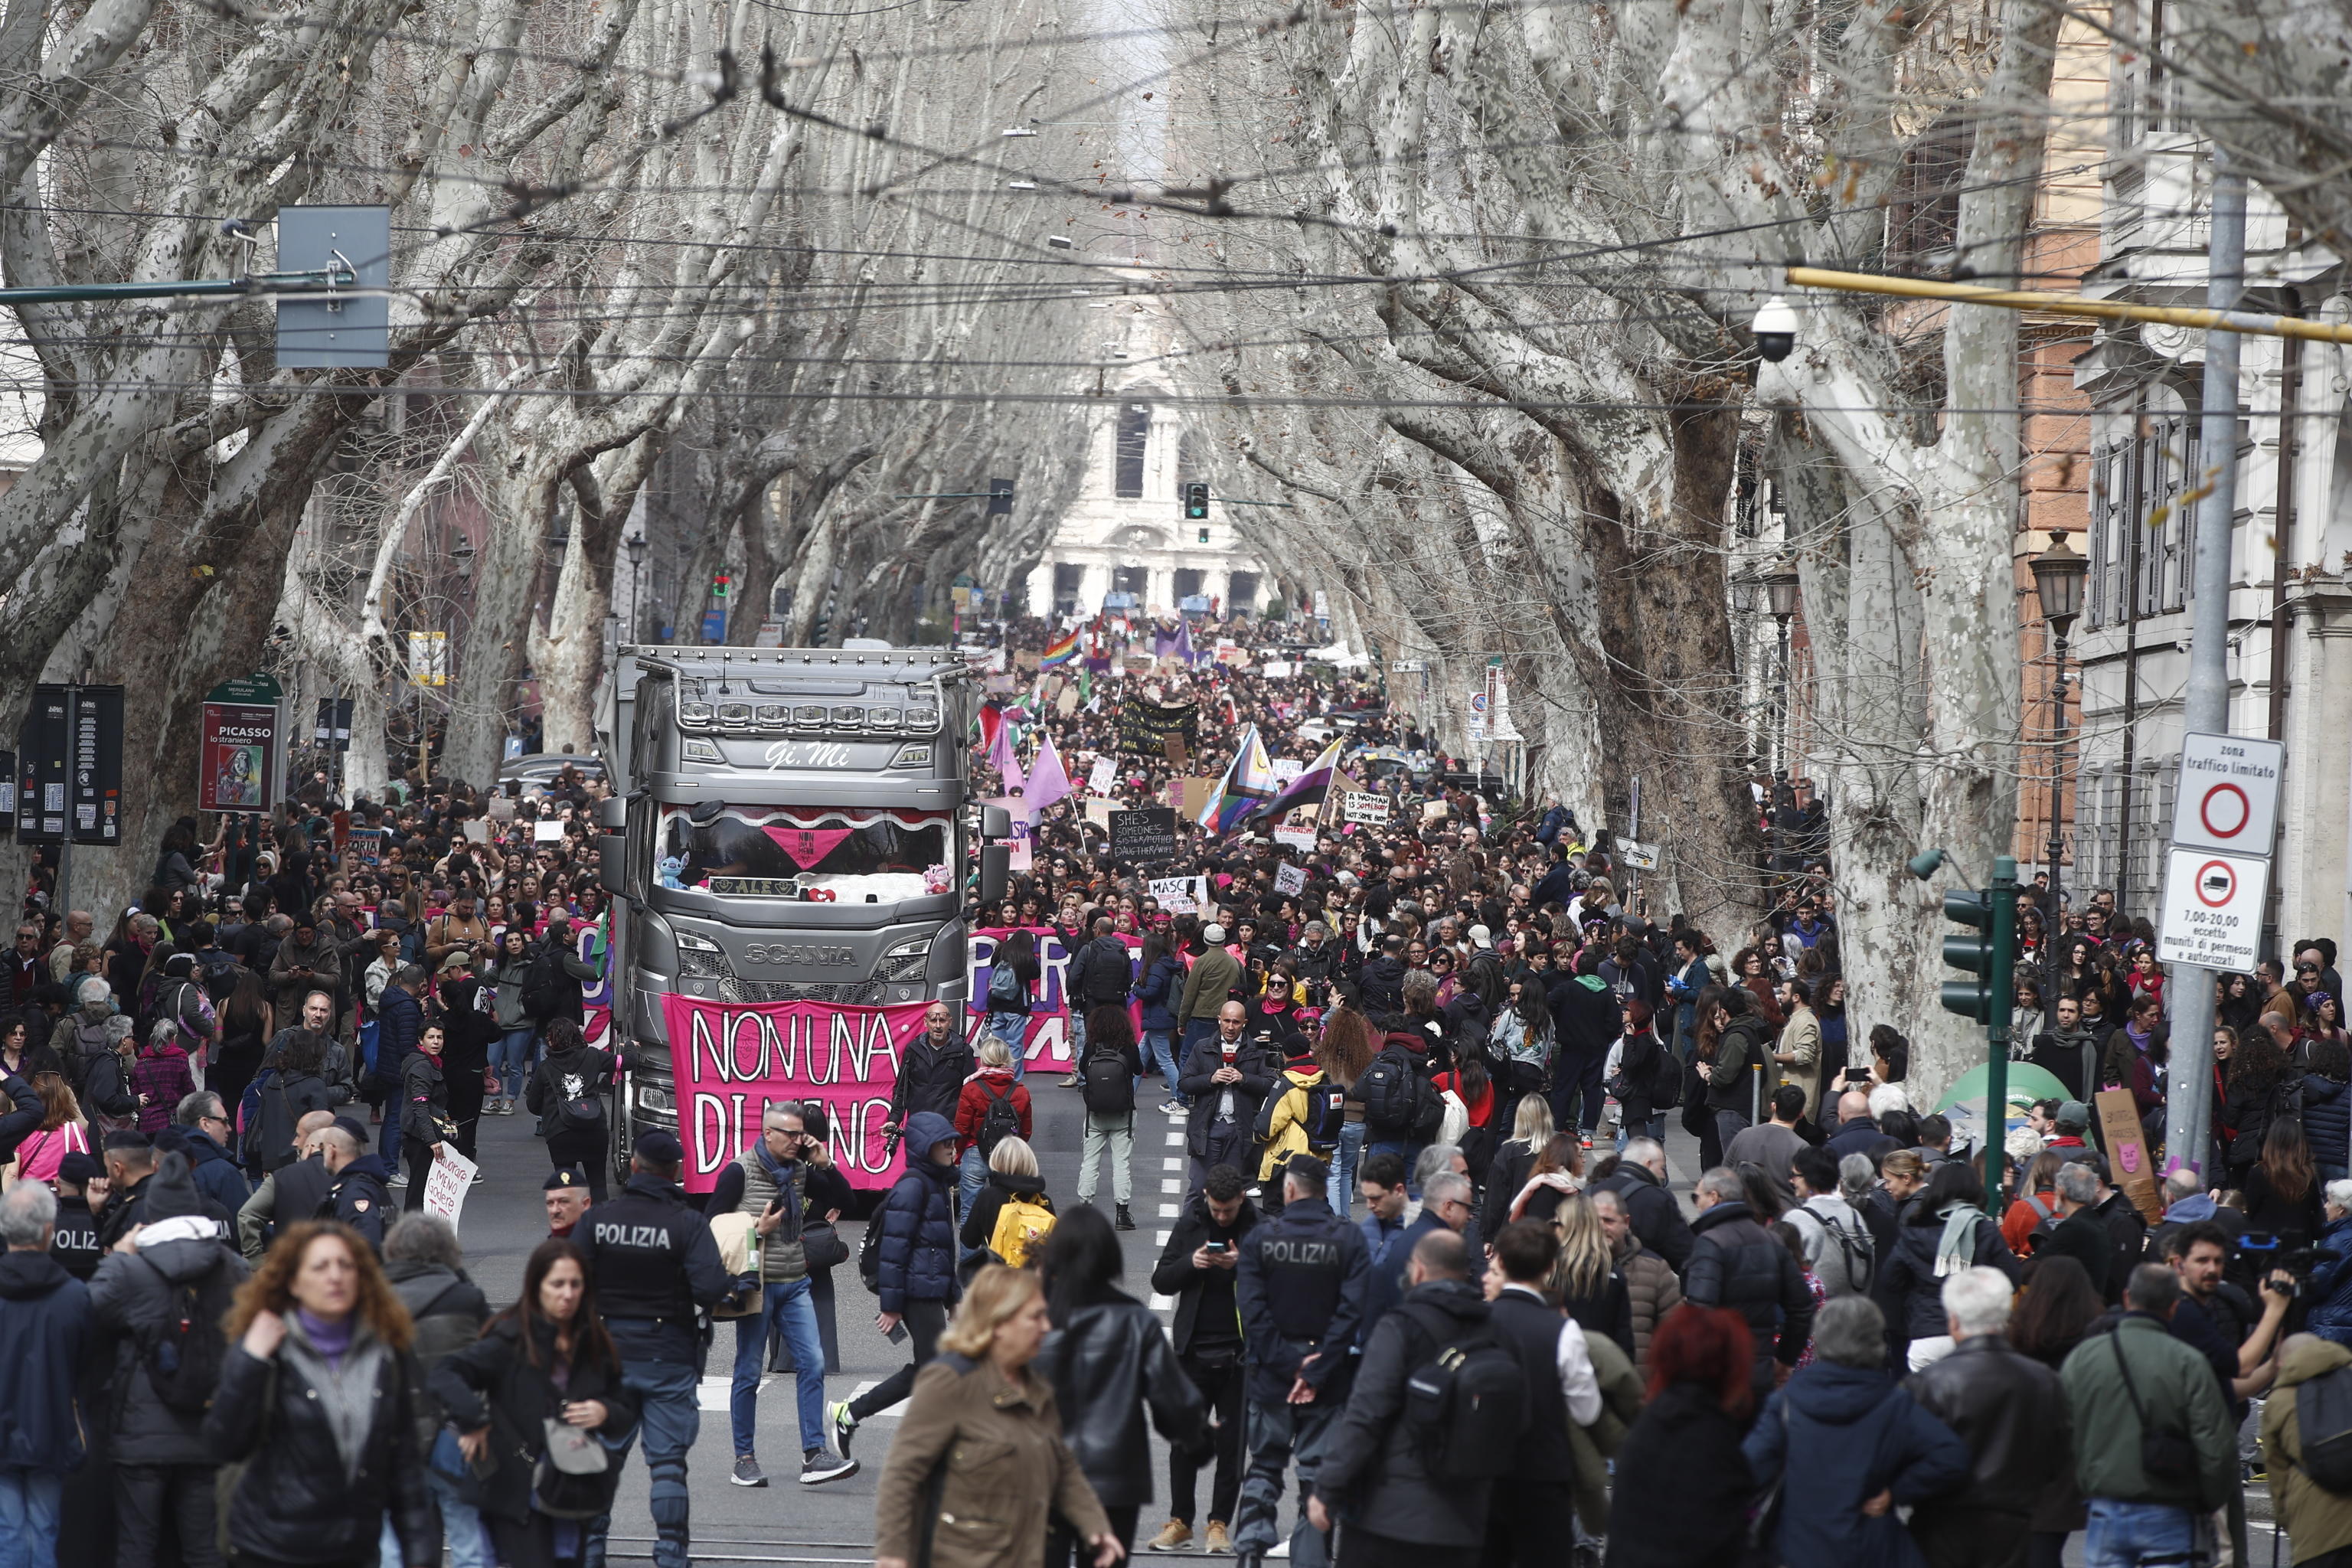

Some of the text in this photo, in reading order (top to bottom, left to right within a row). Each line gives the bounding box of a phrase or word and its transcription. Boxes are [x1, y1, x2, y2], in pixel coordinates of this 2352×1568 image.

[219, 727, 271, 737] PICASSO
[219, 736, 252, 744] straniero
[512, 740, 519, 750] P
[2220, 745, 2245, 757] zona
[2187, 756, 2275, 779] traffico limitato
[1357, 794, 1388, 804] WOMAN
[1357, 802, 1387, 810] SOMEBODY
[1117, 812, 1148, 826] SHE'S
[1358, 812, 1372, 821] SOME
[1374, 815, 1386, 823] BODY
[799, 831, 814, 842] NON
[1117, 824, 1162, 837] SOMEONE'S
[1276, 825, 1315, 835] FEMMINISMO
[350, 841, 377, 851] ORIA
[1116, 835, 1174, 845] SISTER/MOTHER
[736, 880, 772, 894] ALE
[2194, 927, 2227, 939] eccetto
[2164, 936, 2253, 956] muniti di permesso
[744, 942, 858, 967] SCANIA
[2188, 952, 2236, 966] autorizzati
[692, 1008, 796, 1084] NON
[805, 1011, 900, 1086] UNA
[693, 1092, 893, 1174] DI NO
[436, 1170, 458, 1195] MENO
[427, 1178, 455, 1212] Godere
[596, 1223, 671, 1250] POLIZIA
[1262, 1240, 1339, 1265] POLIZIA
